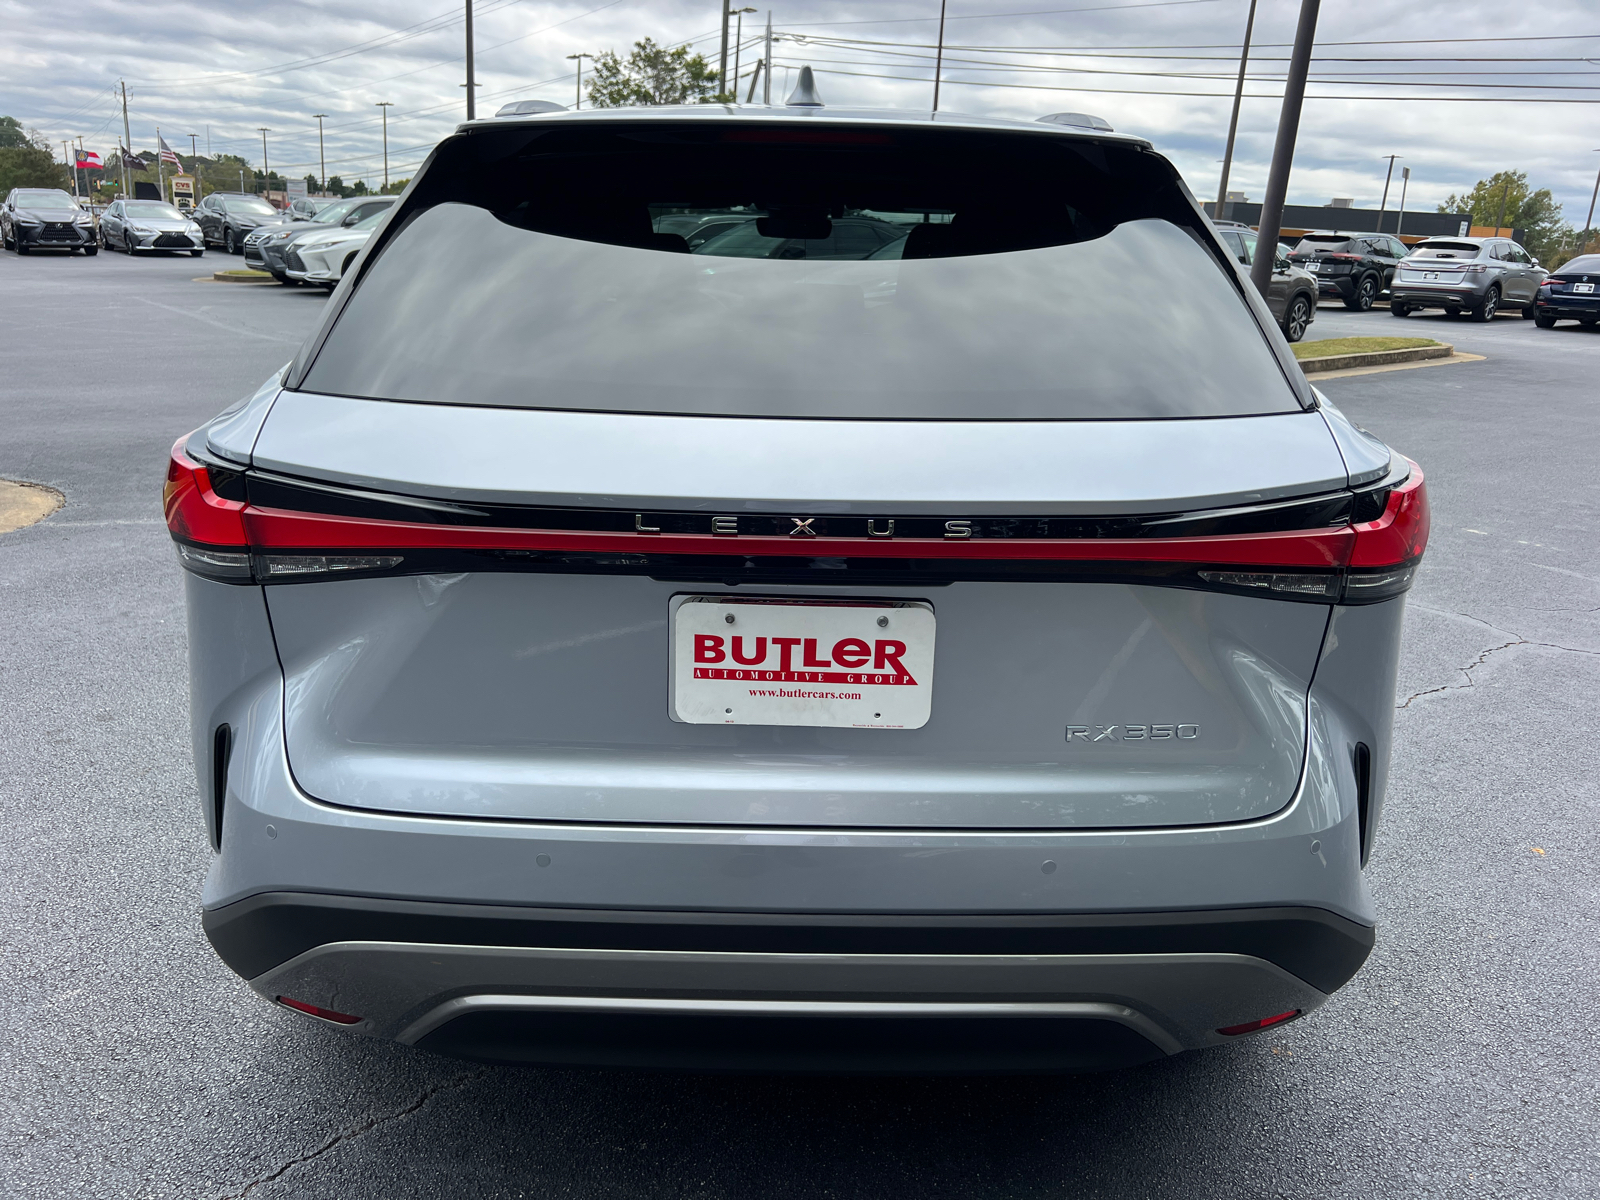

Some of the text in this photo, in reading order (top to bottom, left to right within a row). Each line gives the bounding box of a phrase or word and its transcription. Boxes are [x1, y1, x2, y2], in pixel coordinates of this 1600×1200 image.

[635, 514, 972, 537] LEXUS
[694, 669, 911, 684] AUTOMOTIVE GROUP
[748, 688, 862, 700] www.butlercars.com
